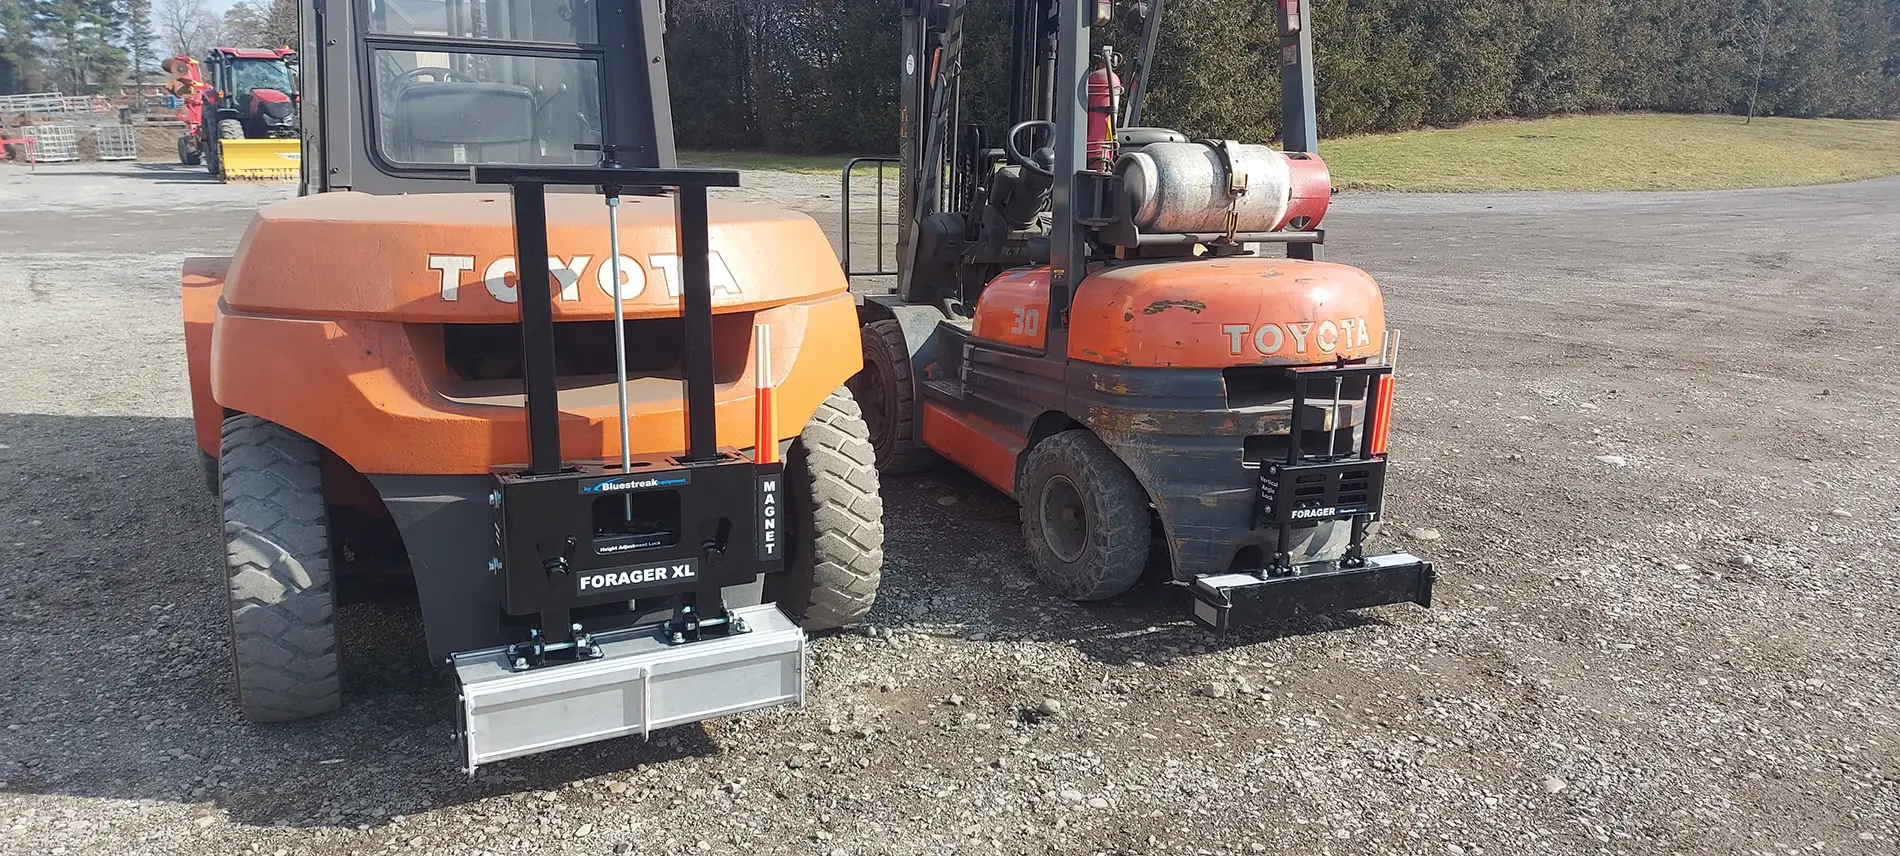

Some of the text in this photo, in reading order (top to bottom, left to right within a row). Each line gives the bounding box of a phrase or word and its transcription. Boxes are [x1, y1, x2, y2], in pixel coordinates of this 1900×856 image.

[428, 250, 743, 303] TOYOTA
[1011, 306, 1040, 337] 30
[1222, 316, 1371, 356] TOYOTA
[602, 478, 658, 491] Bluestreak
[1260, 475, 1279, 488] Vertical
[763, 481, 776, 555] MAGNET
[1291, 507, 1336, 519] FORAGER
[618, 542, 648, 550] Adjustment
[580, 564, 695, 590] FORAGER XL
